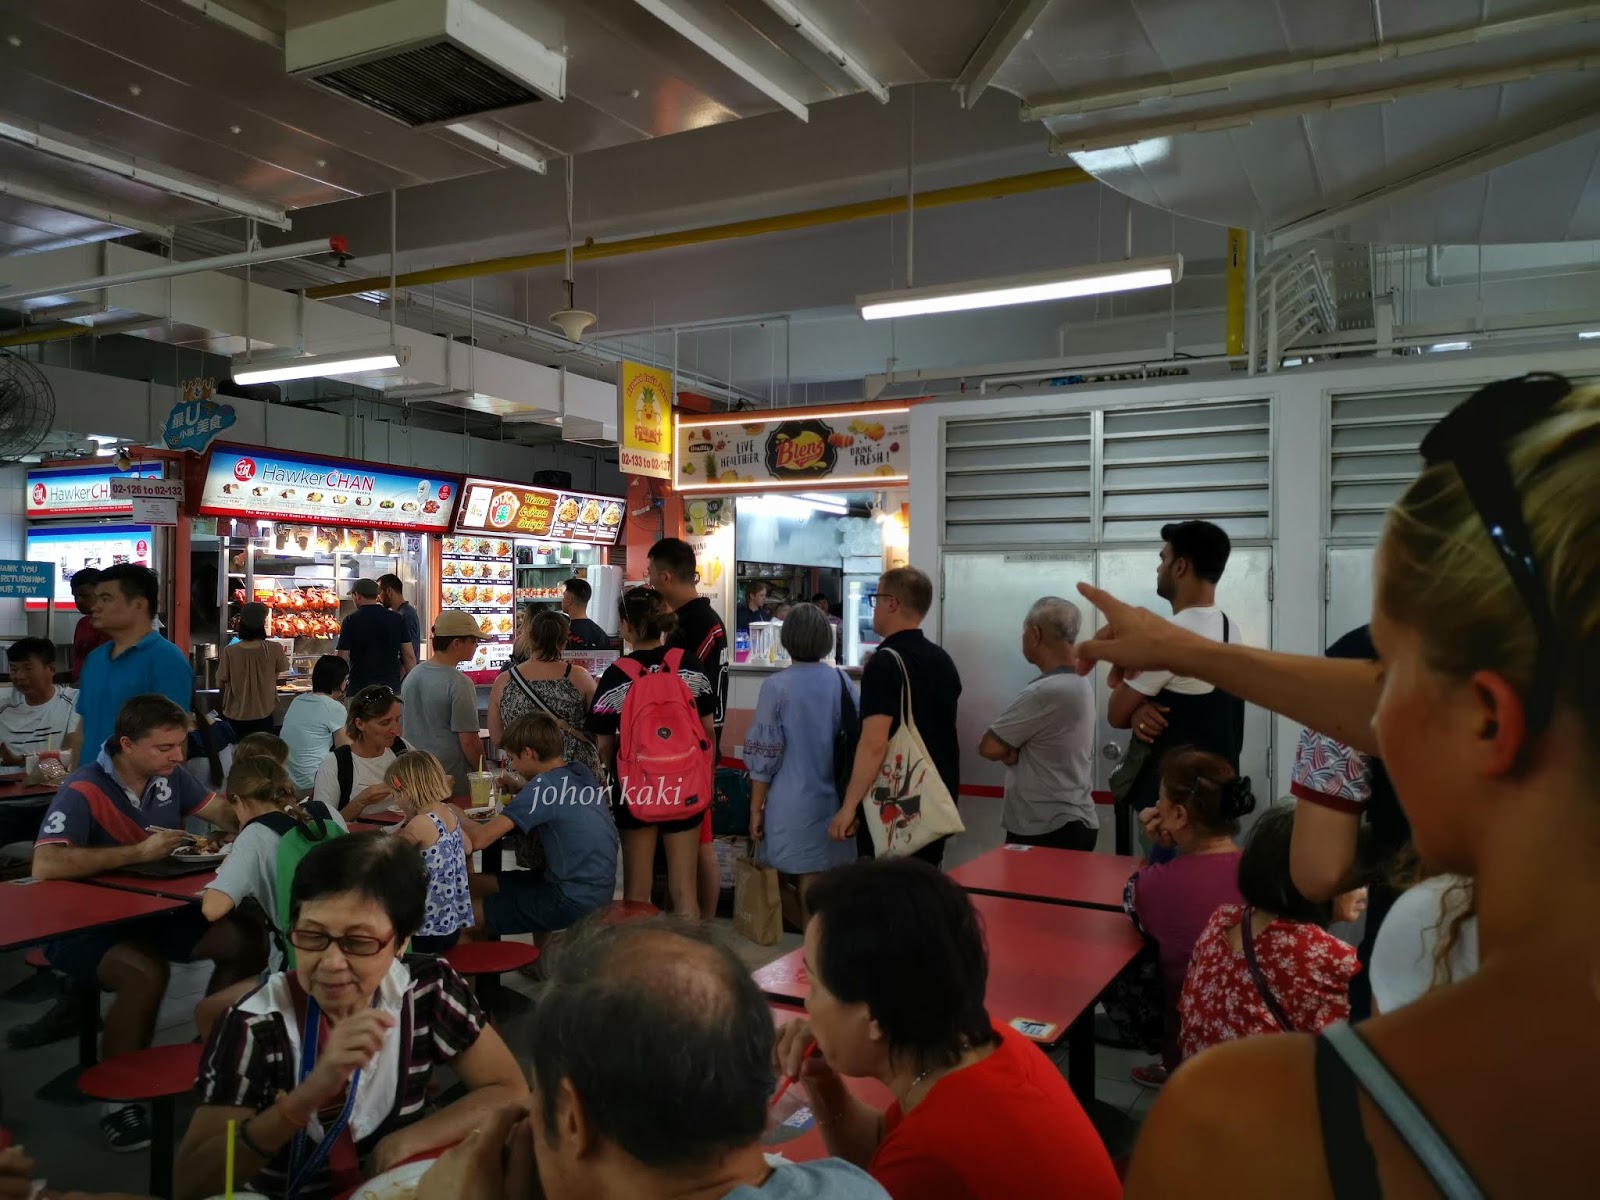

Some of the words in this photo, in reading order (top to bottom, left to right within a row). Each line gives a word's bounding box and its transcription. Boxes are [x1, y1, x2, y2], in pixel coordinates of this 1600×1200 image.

[621, 453, 643, 468] 02-133
[643, 457, 651, 469] to
[651, 458, 671, 472] 02-137
[262, 463, 375, 492] HawkerCHAN
[50, 483, 111, 501] HawkerCH
[112, 484, 142, 494] 02-126
[143, 485, 153, 494] to
[155, 485, 182, 496] 02-132
[21, 565, 38, 574] YOU
[1, 575, 47, 584] RETURNING
[16, 585, 38, 594] TRAY
[155, 777, 172, 802] 3
[43, 811, 67, 834] 3
